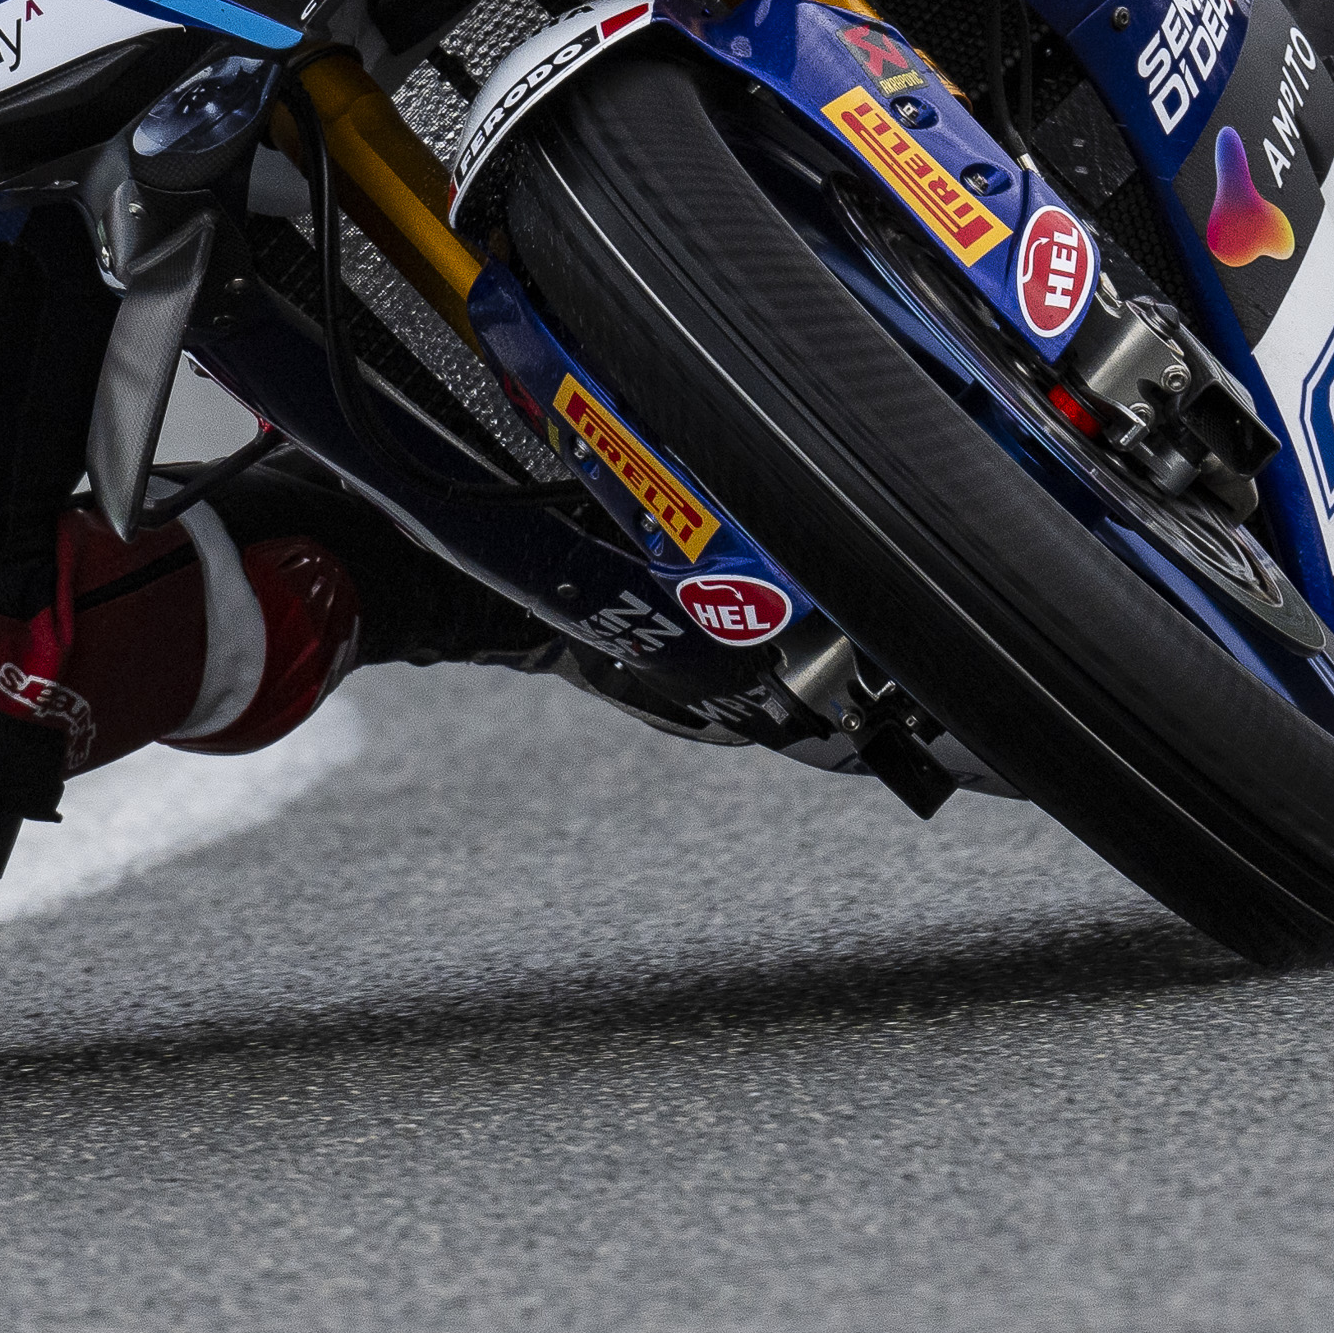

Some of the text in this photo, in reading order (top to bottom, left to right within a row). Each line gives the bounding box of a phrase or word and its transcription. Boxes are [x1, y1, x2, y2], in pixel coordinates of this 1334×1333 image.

[461, 43, 583, 177] FERODO
[841, 101, 994, 250] PIRELLI
[1263, 26, 1317, 189] AMPITO
[1044, 226, 1080, 310] HEL
[565, 390, 703, 544] PIRELLI
[693, 601, 771, 632] HEL
